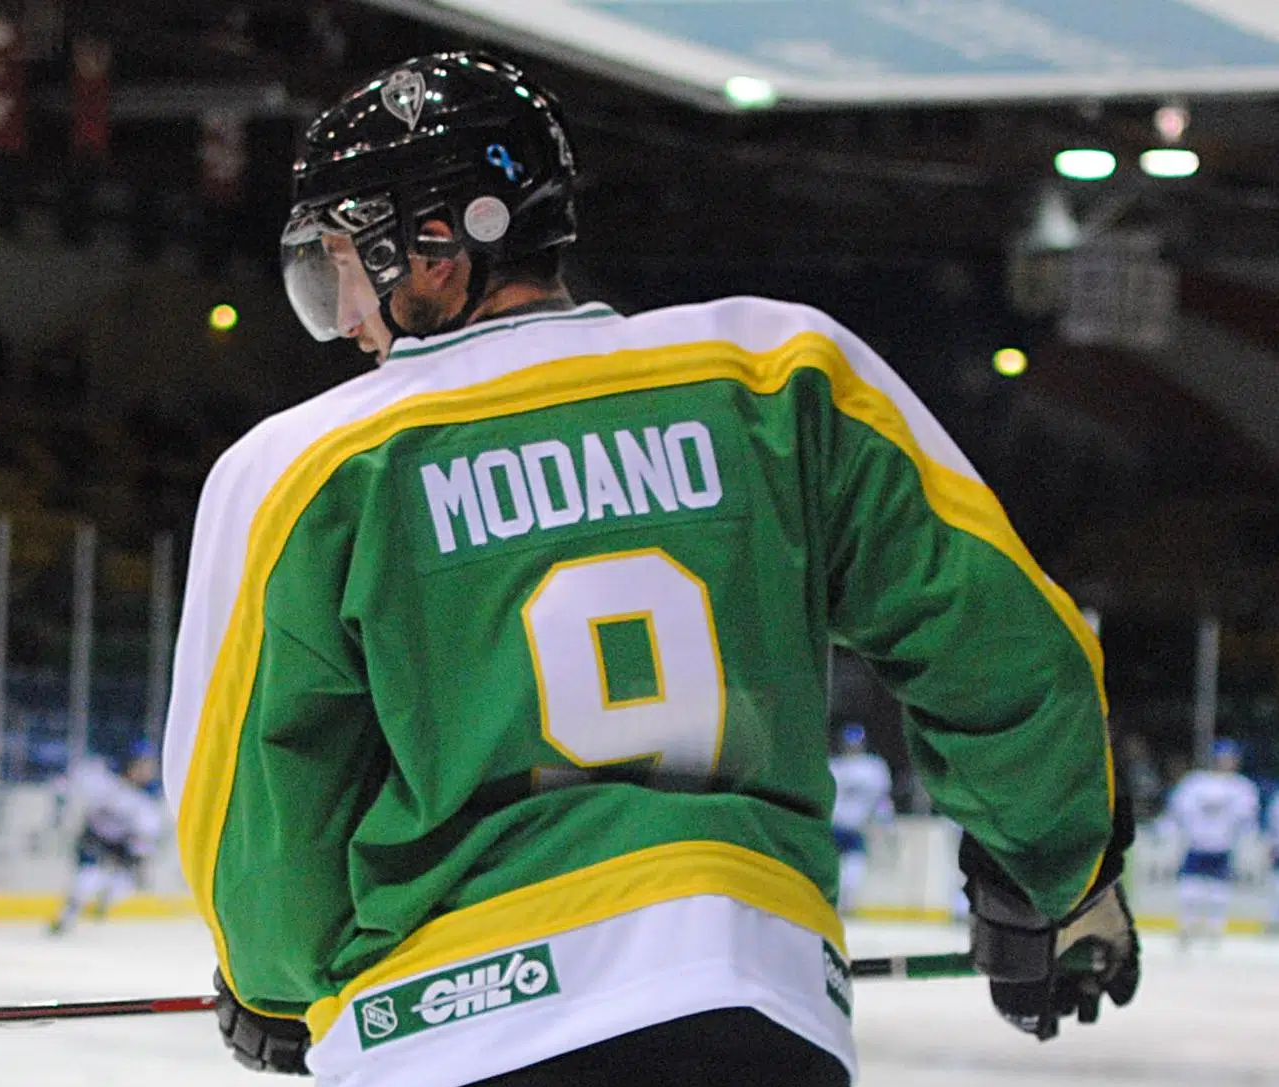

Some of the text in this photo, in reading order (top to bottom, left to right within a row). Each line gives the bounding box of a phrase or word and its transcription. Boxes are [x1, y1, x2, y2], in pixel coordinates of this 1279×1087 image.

[420, 420, 723, 553] MODANO
[522, 547, 726, 790] 9
[418, 962, 513, 1024] CHL
